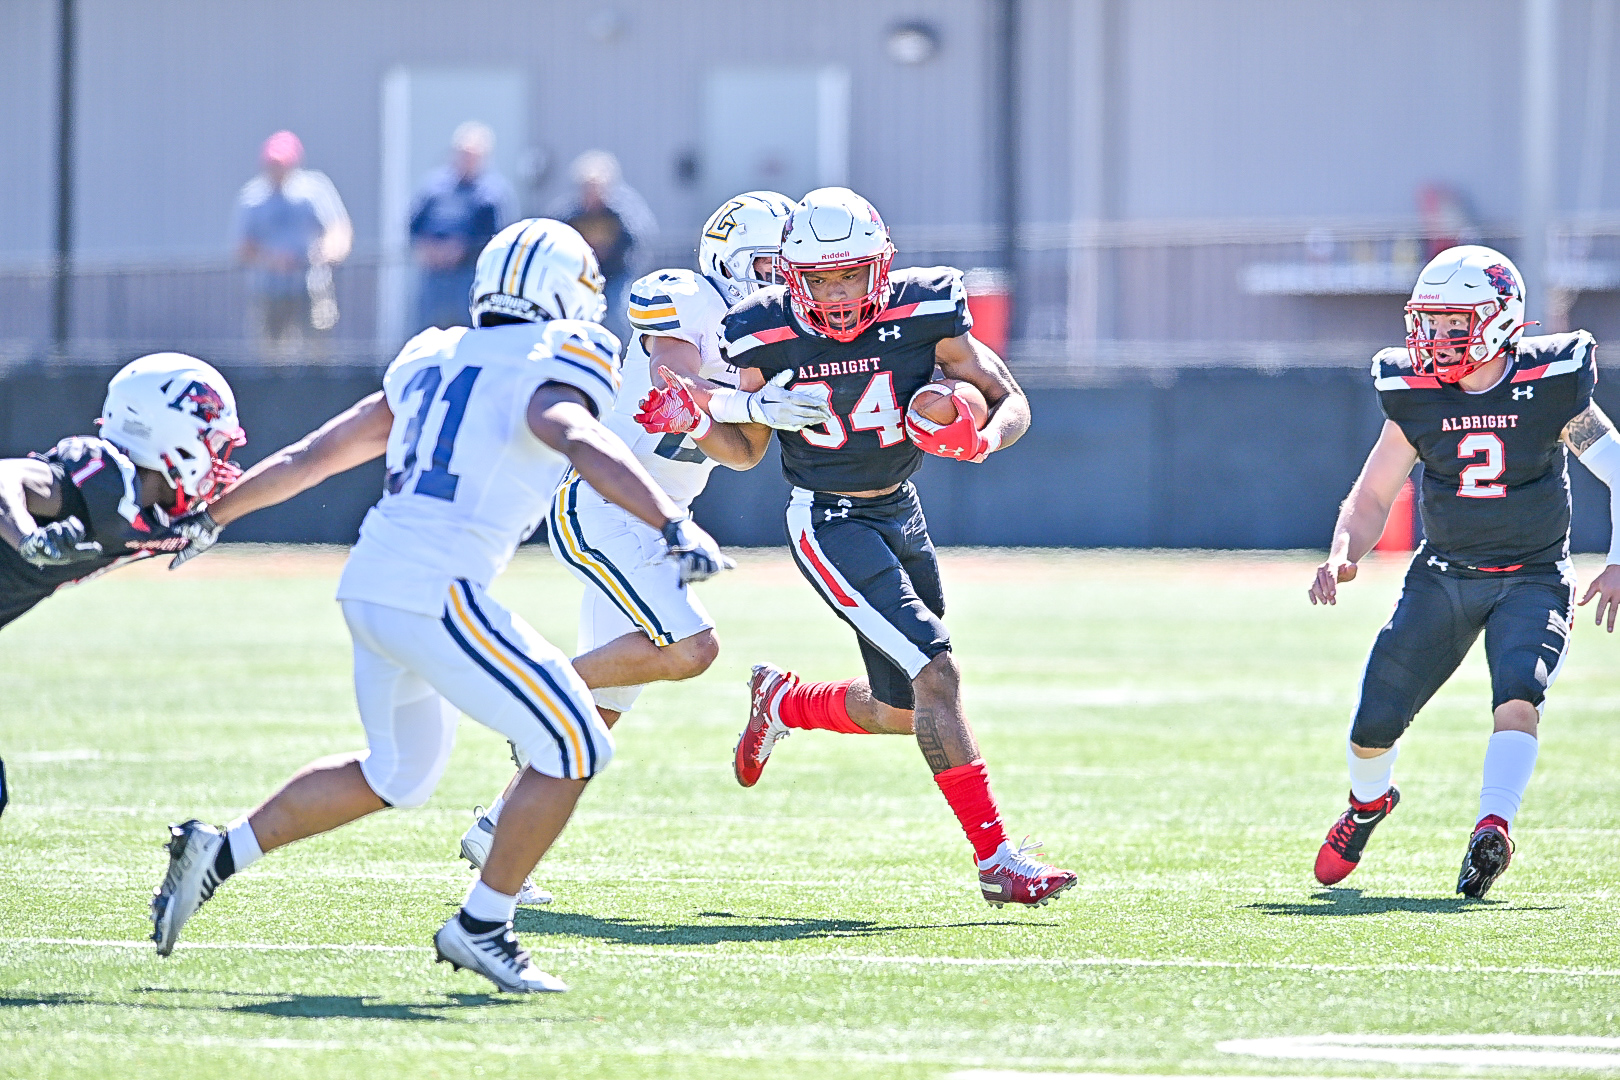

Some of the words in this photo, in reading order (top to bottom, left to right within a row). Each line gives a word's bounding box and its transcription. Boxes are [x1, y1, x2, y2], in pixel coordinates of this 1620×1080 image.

[705, 201, 746, 243] L
[821, 250, 850, 260] Riddell
[798, 357, 881, 379] ALBRIGHT
[1442, 414, 1518, 432] ALBRIGHT
[1456, 432, 1508, 499] 2
